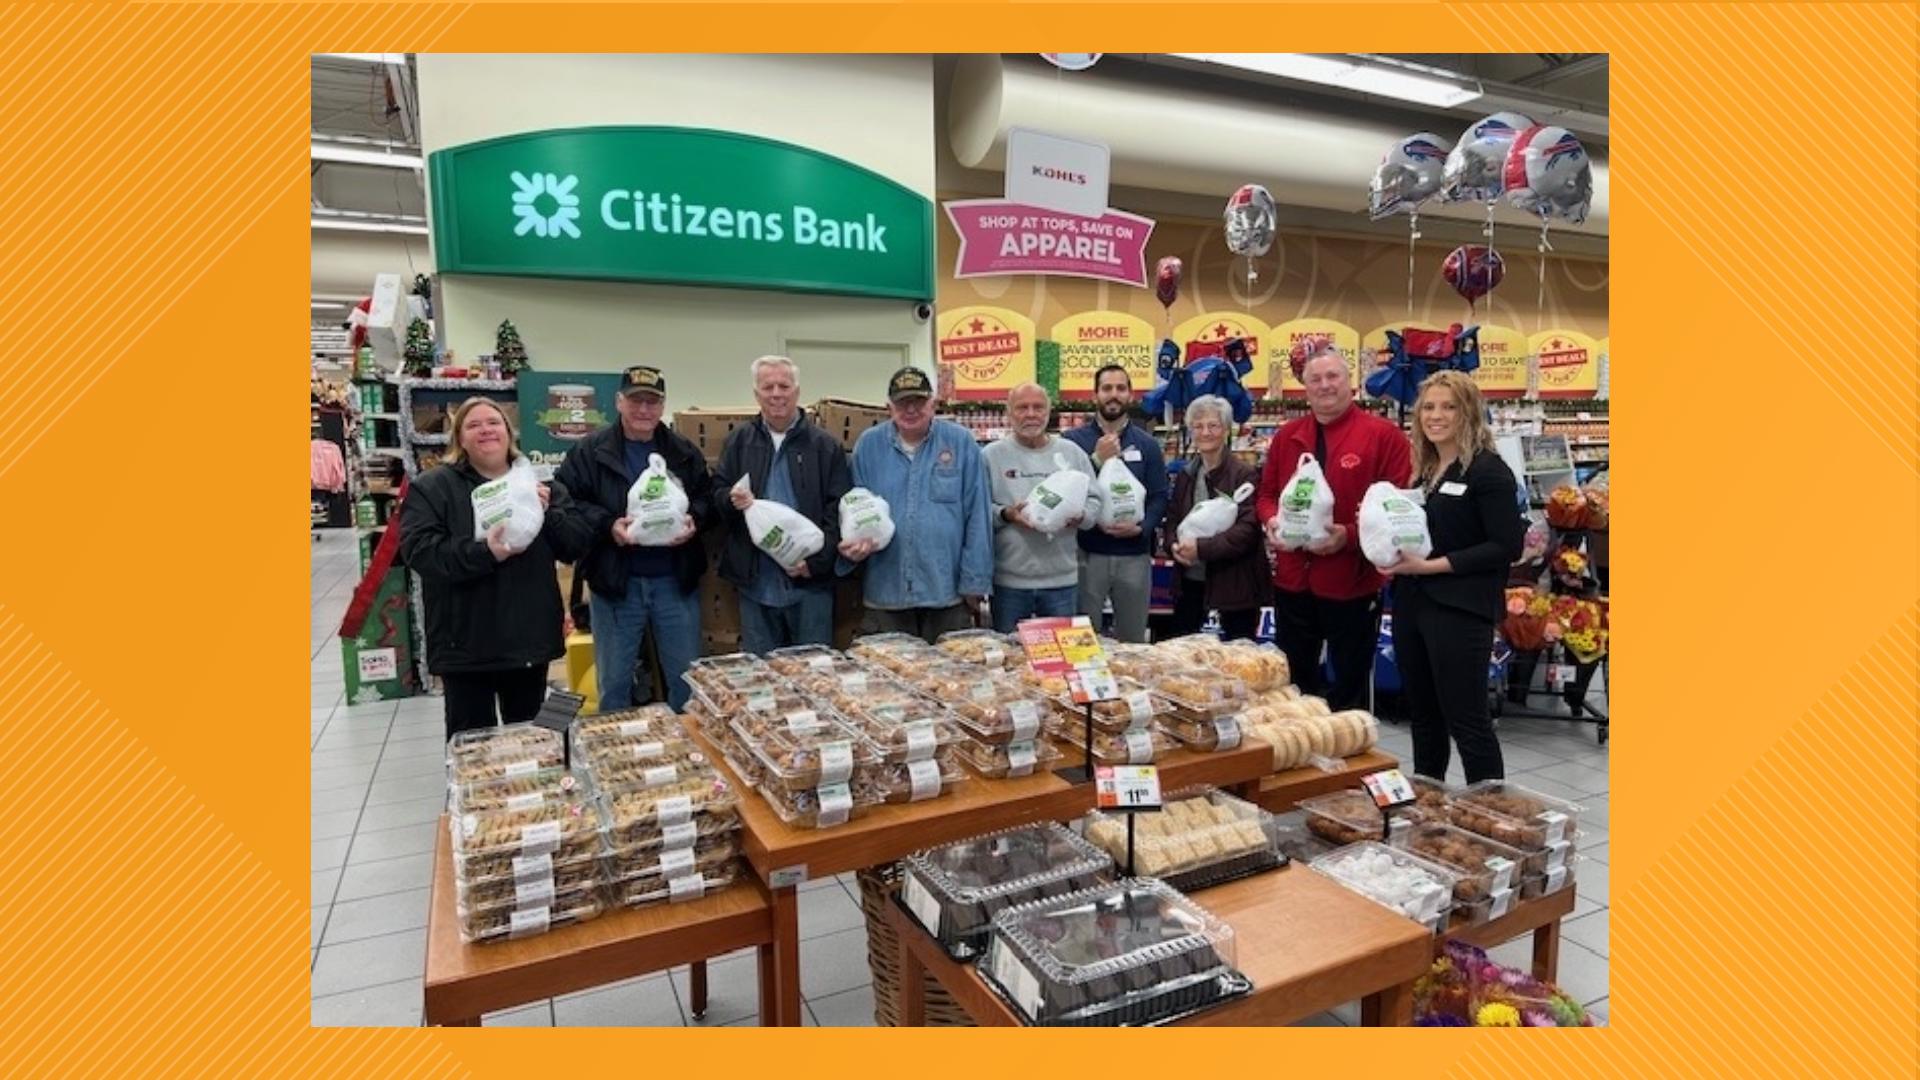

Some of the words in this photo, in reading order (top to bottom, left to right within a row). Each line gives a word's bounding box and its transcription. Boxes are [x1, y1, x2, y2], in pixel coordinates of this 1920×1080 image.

[1031, 165, 1087, 185] KOHL'S
[600, 189, 784, 242] Citizens
[793, 206, 888, 254] Bank
[978, 215, 1018, 229] SHOP
[1021, 217, 1040, 229] AT
[1041, 218, 1079, 233] TOPS,
[1081, 221, 1113, 237] SAVE
[1115, 226, 1134, 240] ON
[999, 232, 1122, 265] APPAREL
[1078, 326, 1129, 338] MORE
[943, 342, 974, 356] BEST
[977, 336, 1018, 353] DEALS
[1116, 344, 1150, 354] WITH
[1480, 342, 1508, 353] ORE
